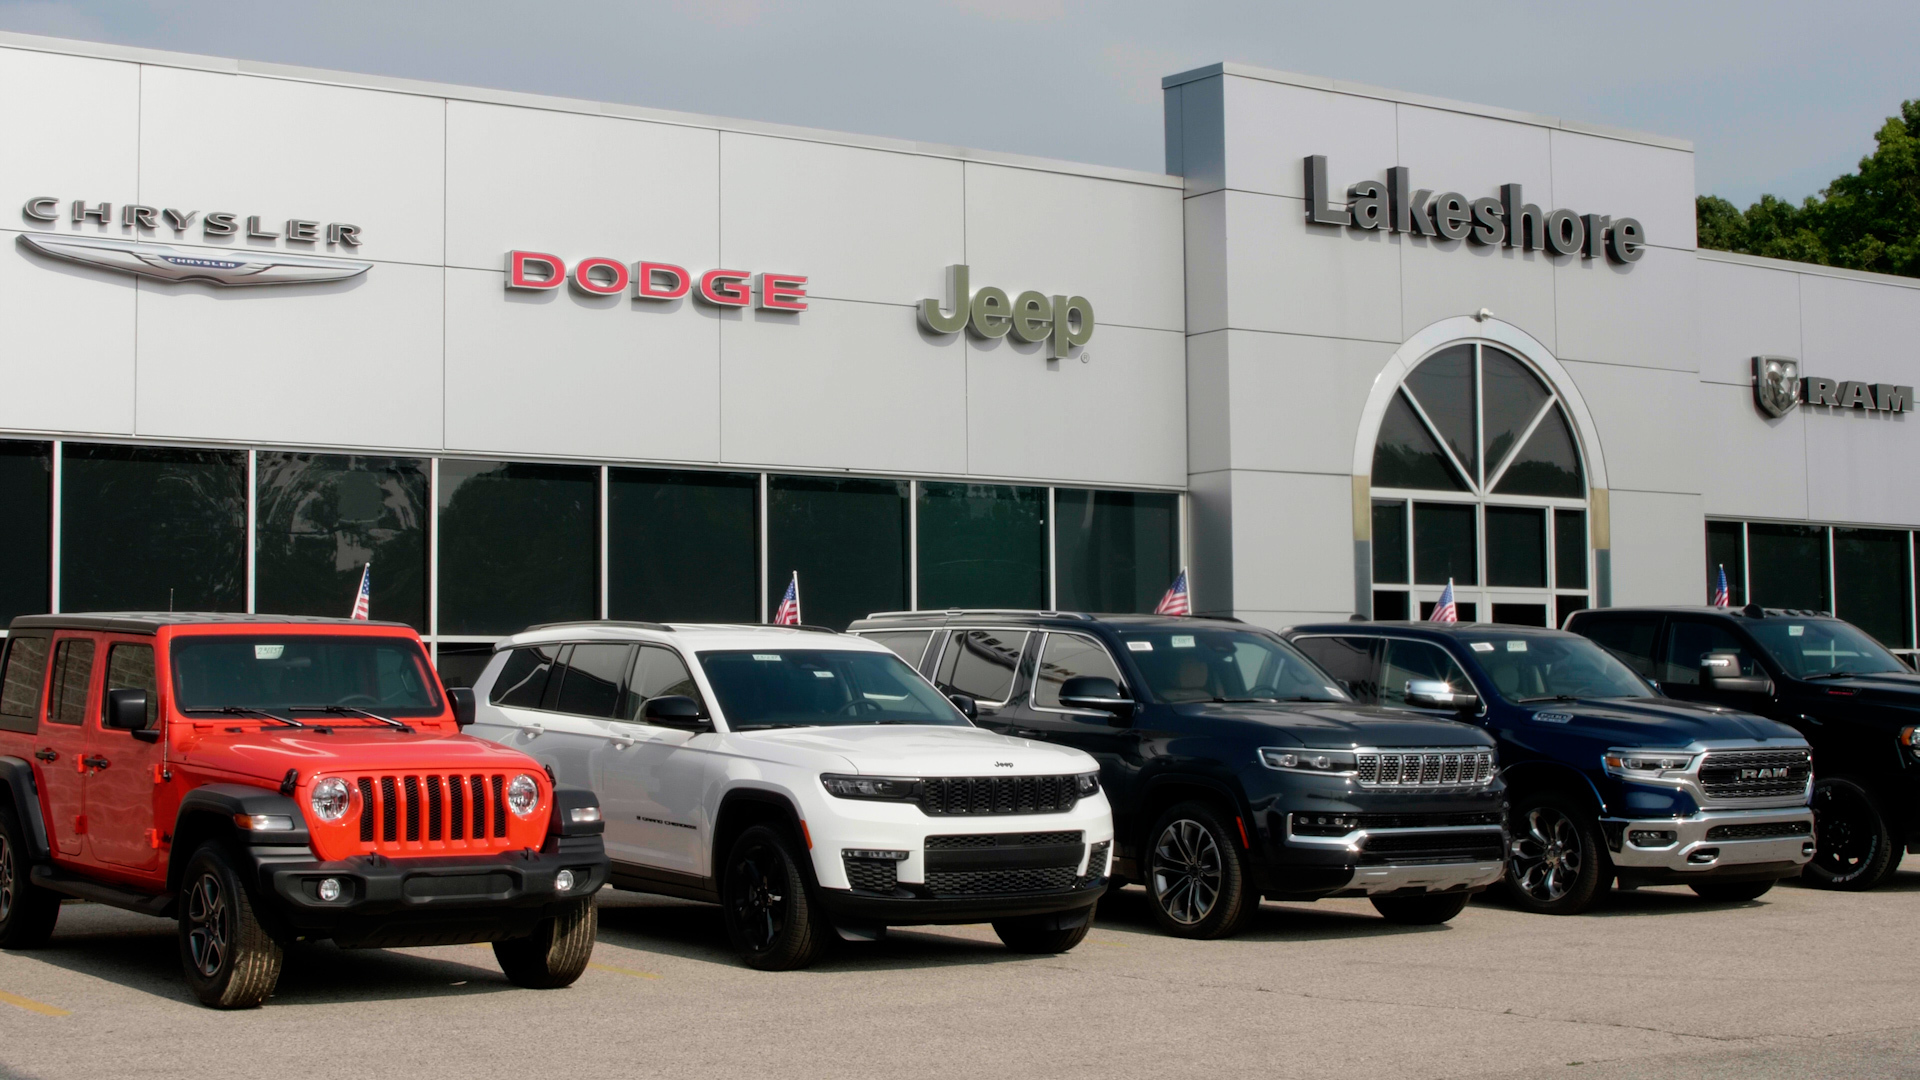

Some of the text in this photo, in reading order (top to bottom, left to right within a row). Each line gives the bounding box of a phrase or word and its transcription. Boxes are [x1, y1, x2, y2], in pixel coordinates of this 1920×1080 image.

[22, 196, 363, 246] CHRYSLER
[1303, 154, 1645, 264] Lakeshore
[167, 257, 236, 268] CHRYSLER
[504, 250, 808, 312] DODGE
[916, 265, 1095, 360] Jeep
[1800, 376, 1914, 413] RAM
[1741, 767, 1788, 779] RAM
